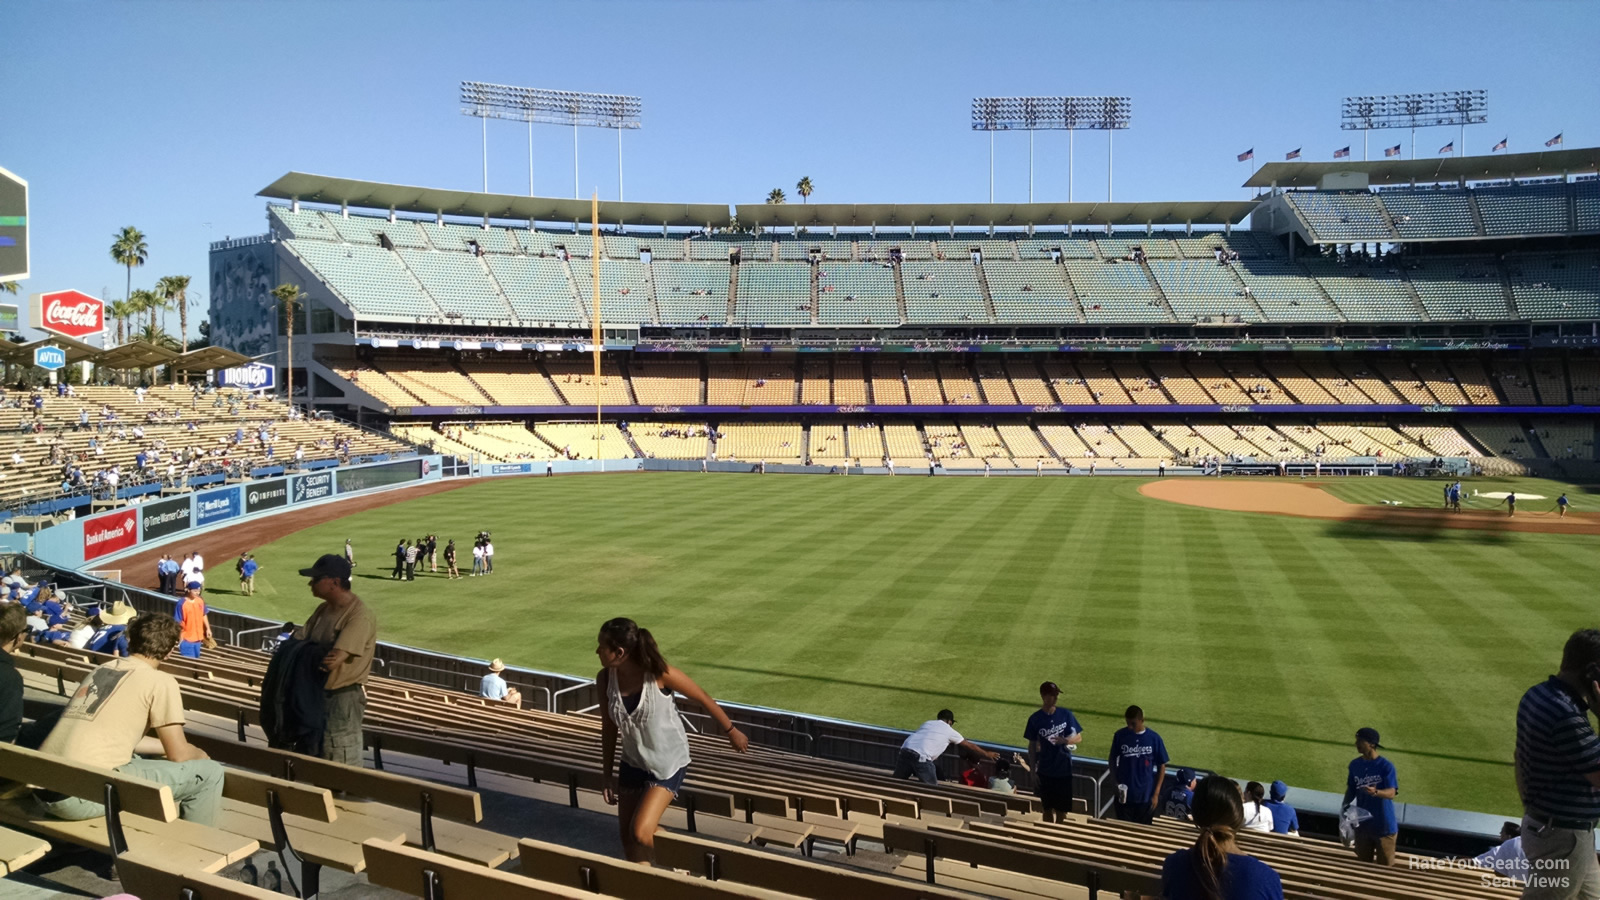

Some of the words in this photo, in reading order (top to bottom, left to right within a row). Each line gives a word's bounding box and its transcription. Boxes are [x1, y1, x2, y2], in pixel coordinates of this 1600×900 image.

[46, 299, 100, 328] Coca-Cola
[39, 351, 63, 363] AVITA
[305, 474, 330, 486] SECURITY
[149, 515, 161, 526] Time
[160, 512, 176, 522] Warner
[86, 531, 99, 547] Bank
[104, 526, 124, 541] America
[1038, 721, 1068, 737] Dodgers
[1120, 744, 1153, 758] Dodgers
[1354, 774, 1382, 786] Dodgers
